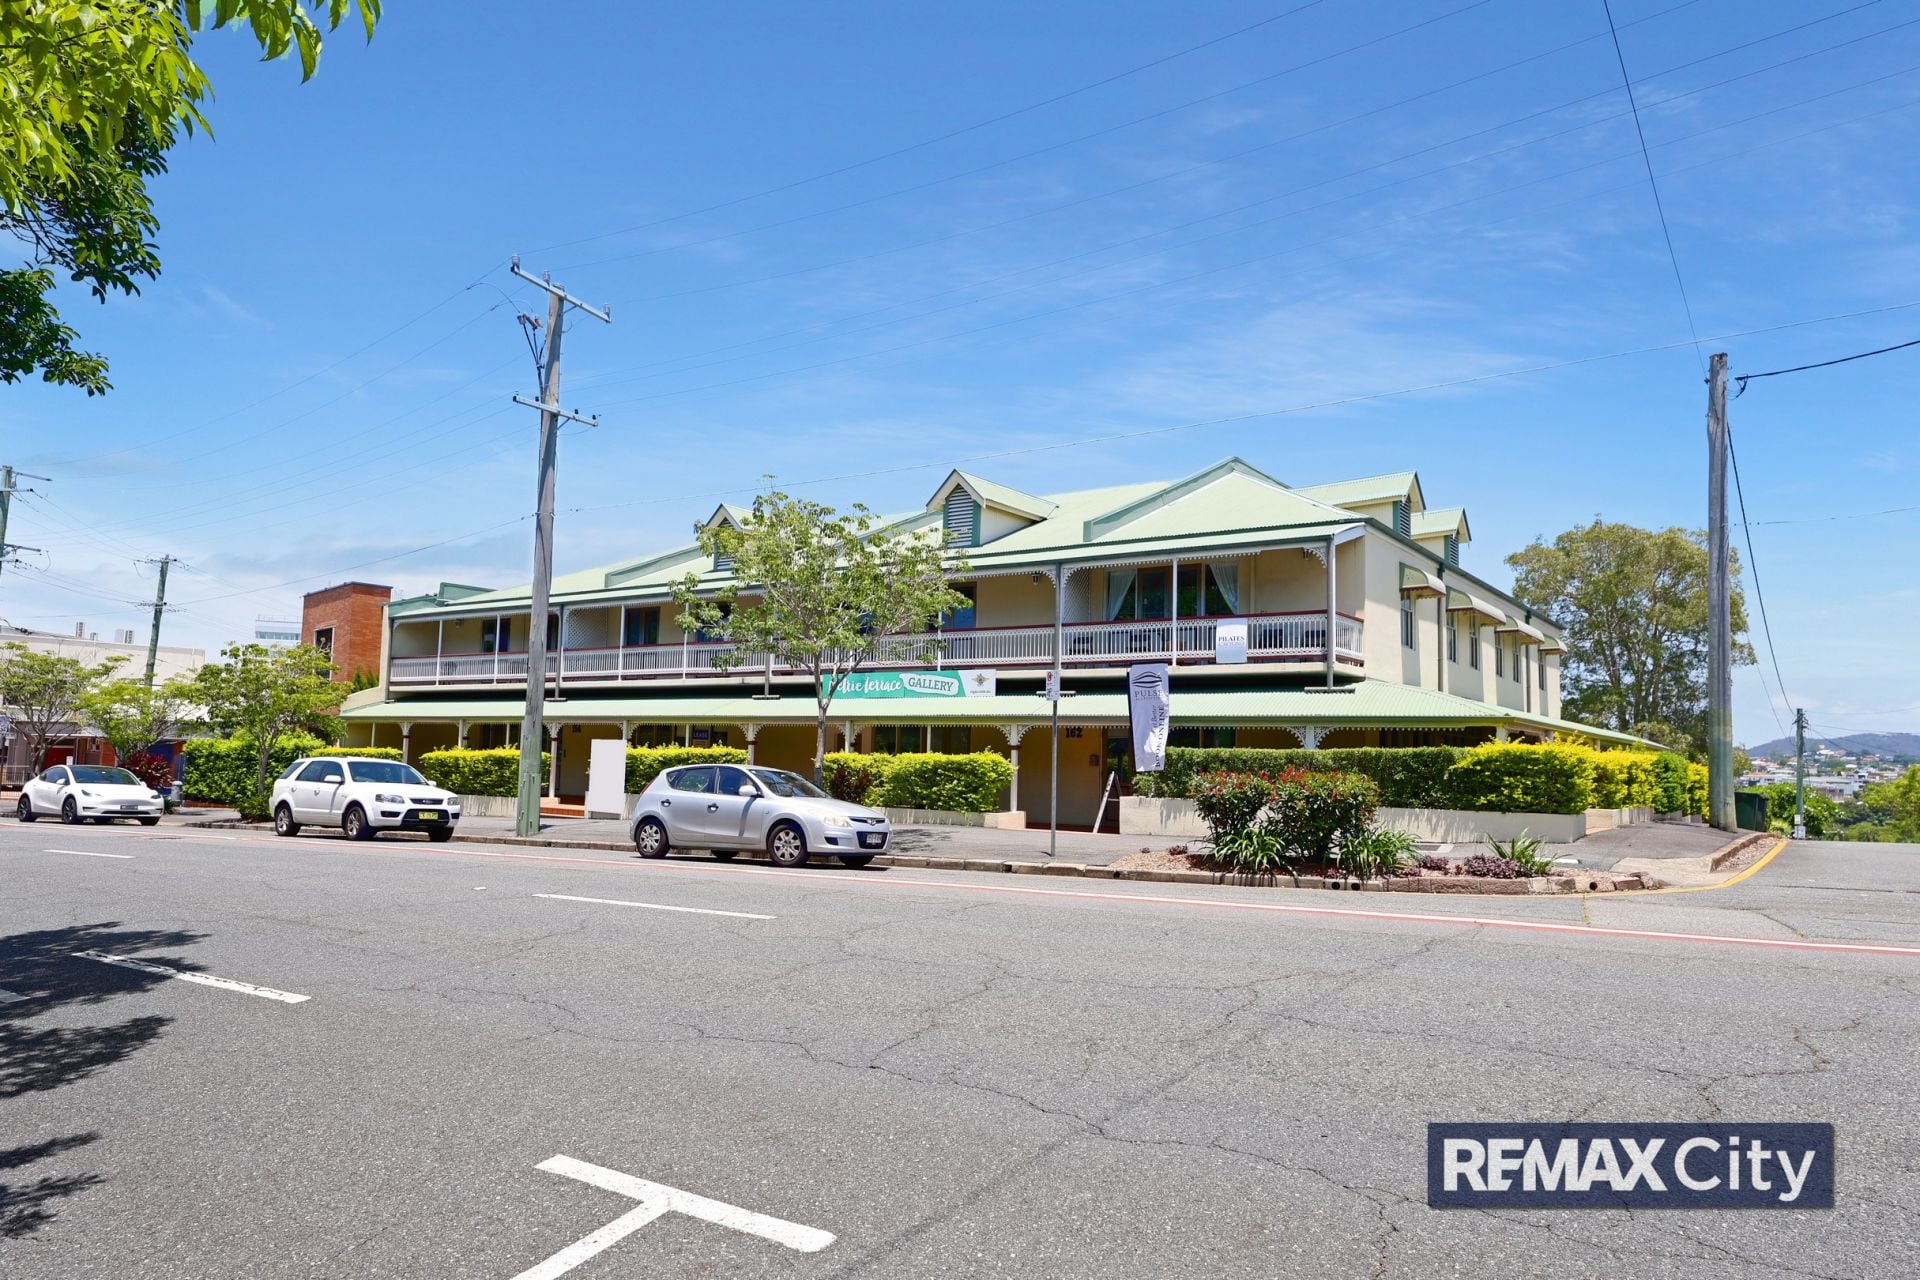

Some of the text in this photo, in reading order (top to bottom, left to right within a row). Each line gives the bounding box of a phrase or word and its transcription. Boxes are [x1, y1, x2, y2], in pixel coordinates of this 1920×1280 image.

[908, 677, 953, 692] GALLERY
[1135, 690, 1163, 698] PULSE
[1066, 727, 1083, 738] 162
